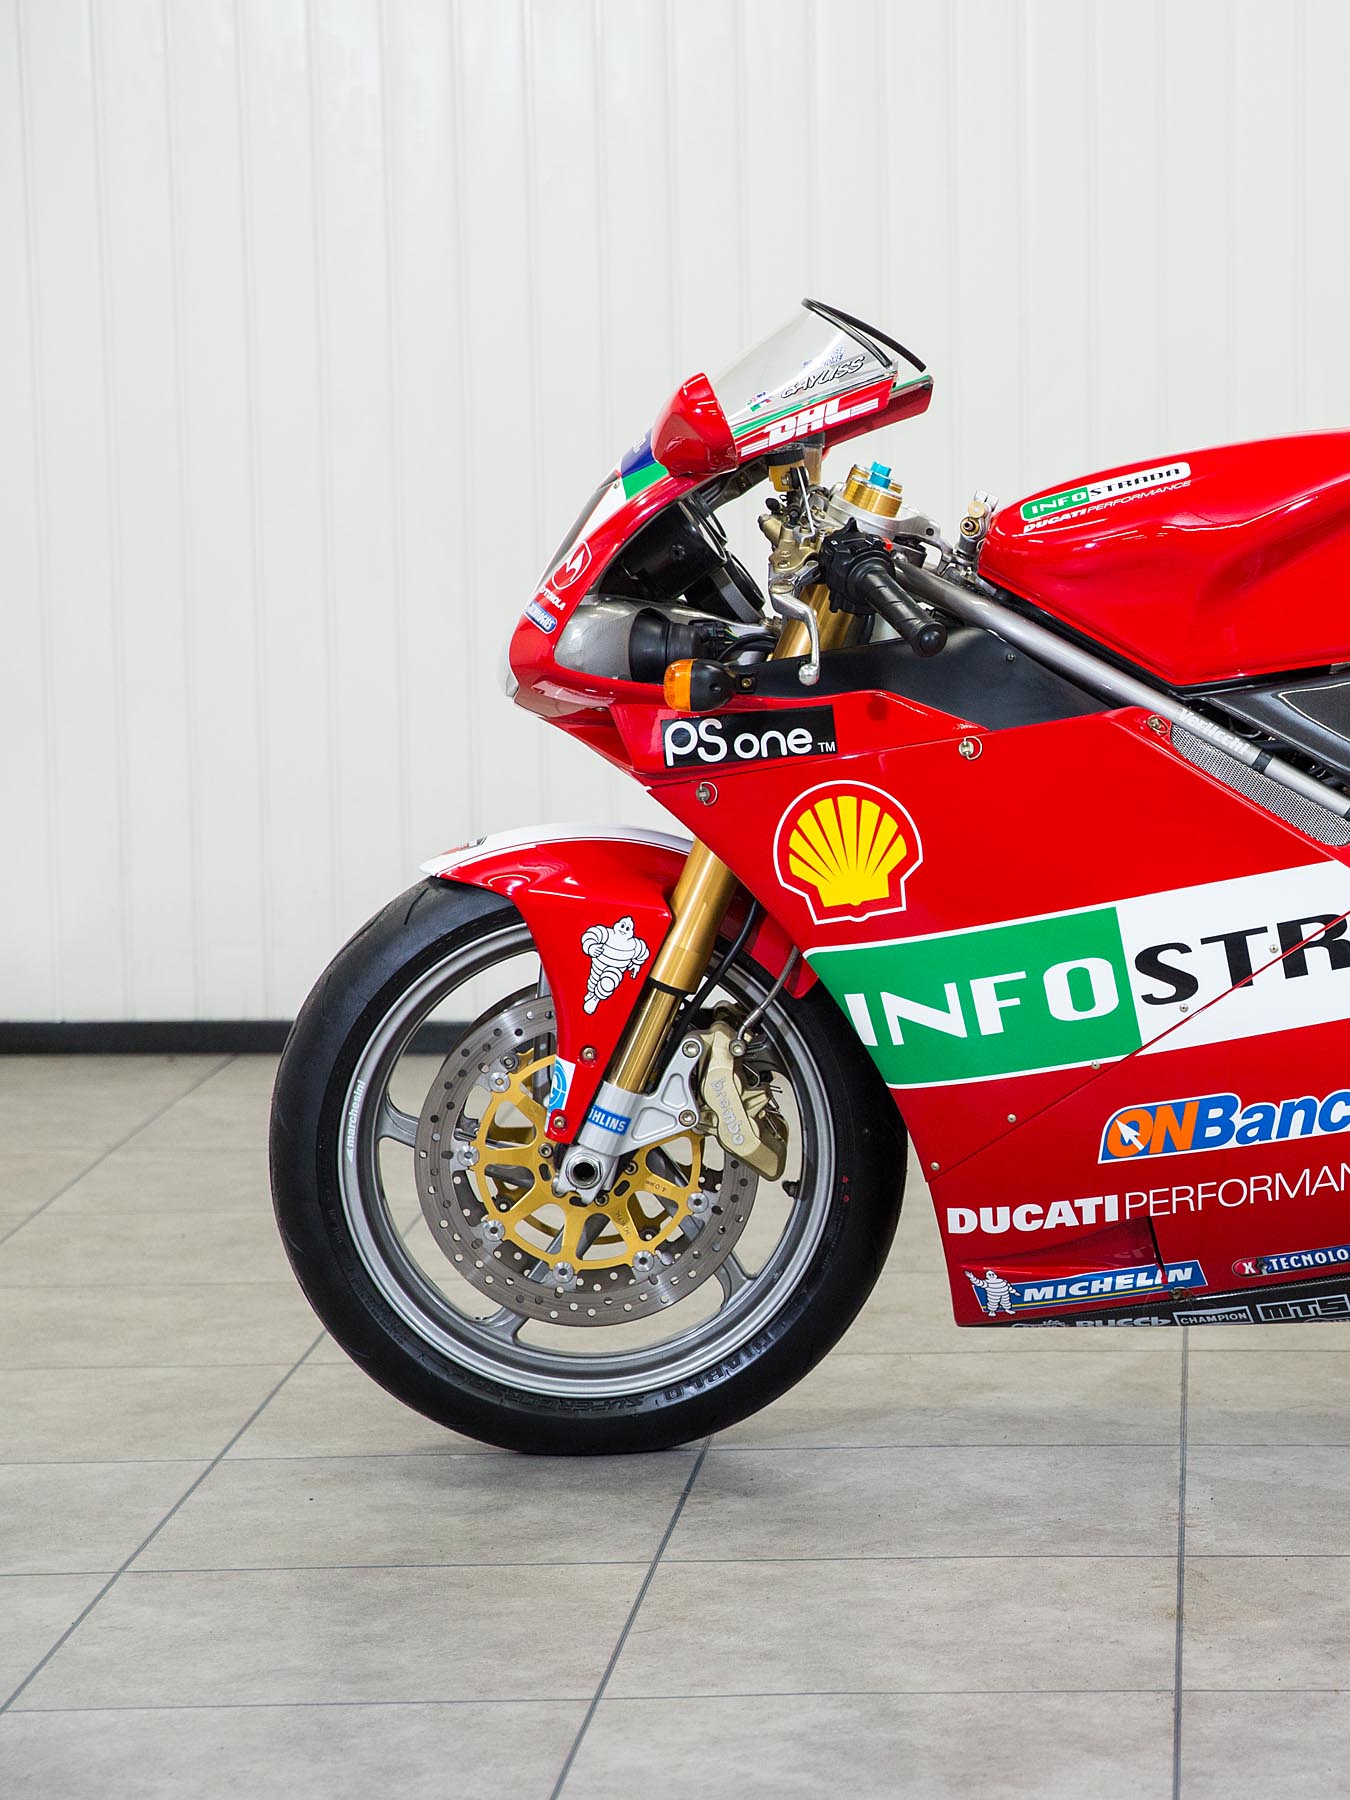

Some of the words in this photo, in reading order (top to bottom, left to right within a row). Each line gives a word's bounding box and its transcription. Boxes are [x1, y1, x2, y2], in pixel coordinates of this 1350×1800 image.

[764, 398, 852, 446] DHL
[1023, 508, 1087, 533] DUCATI
[1087, 480, 1191, 513] PERFORMANCE
[709, 1076, 745, 1146] brembo
[946, 1195, 1118, 1234] DUCATI
[1023, 1267, 1193, 1302] MICHELIN
[1180, 1312, 1247, 1325] CHAMPION
